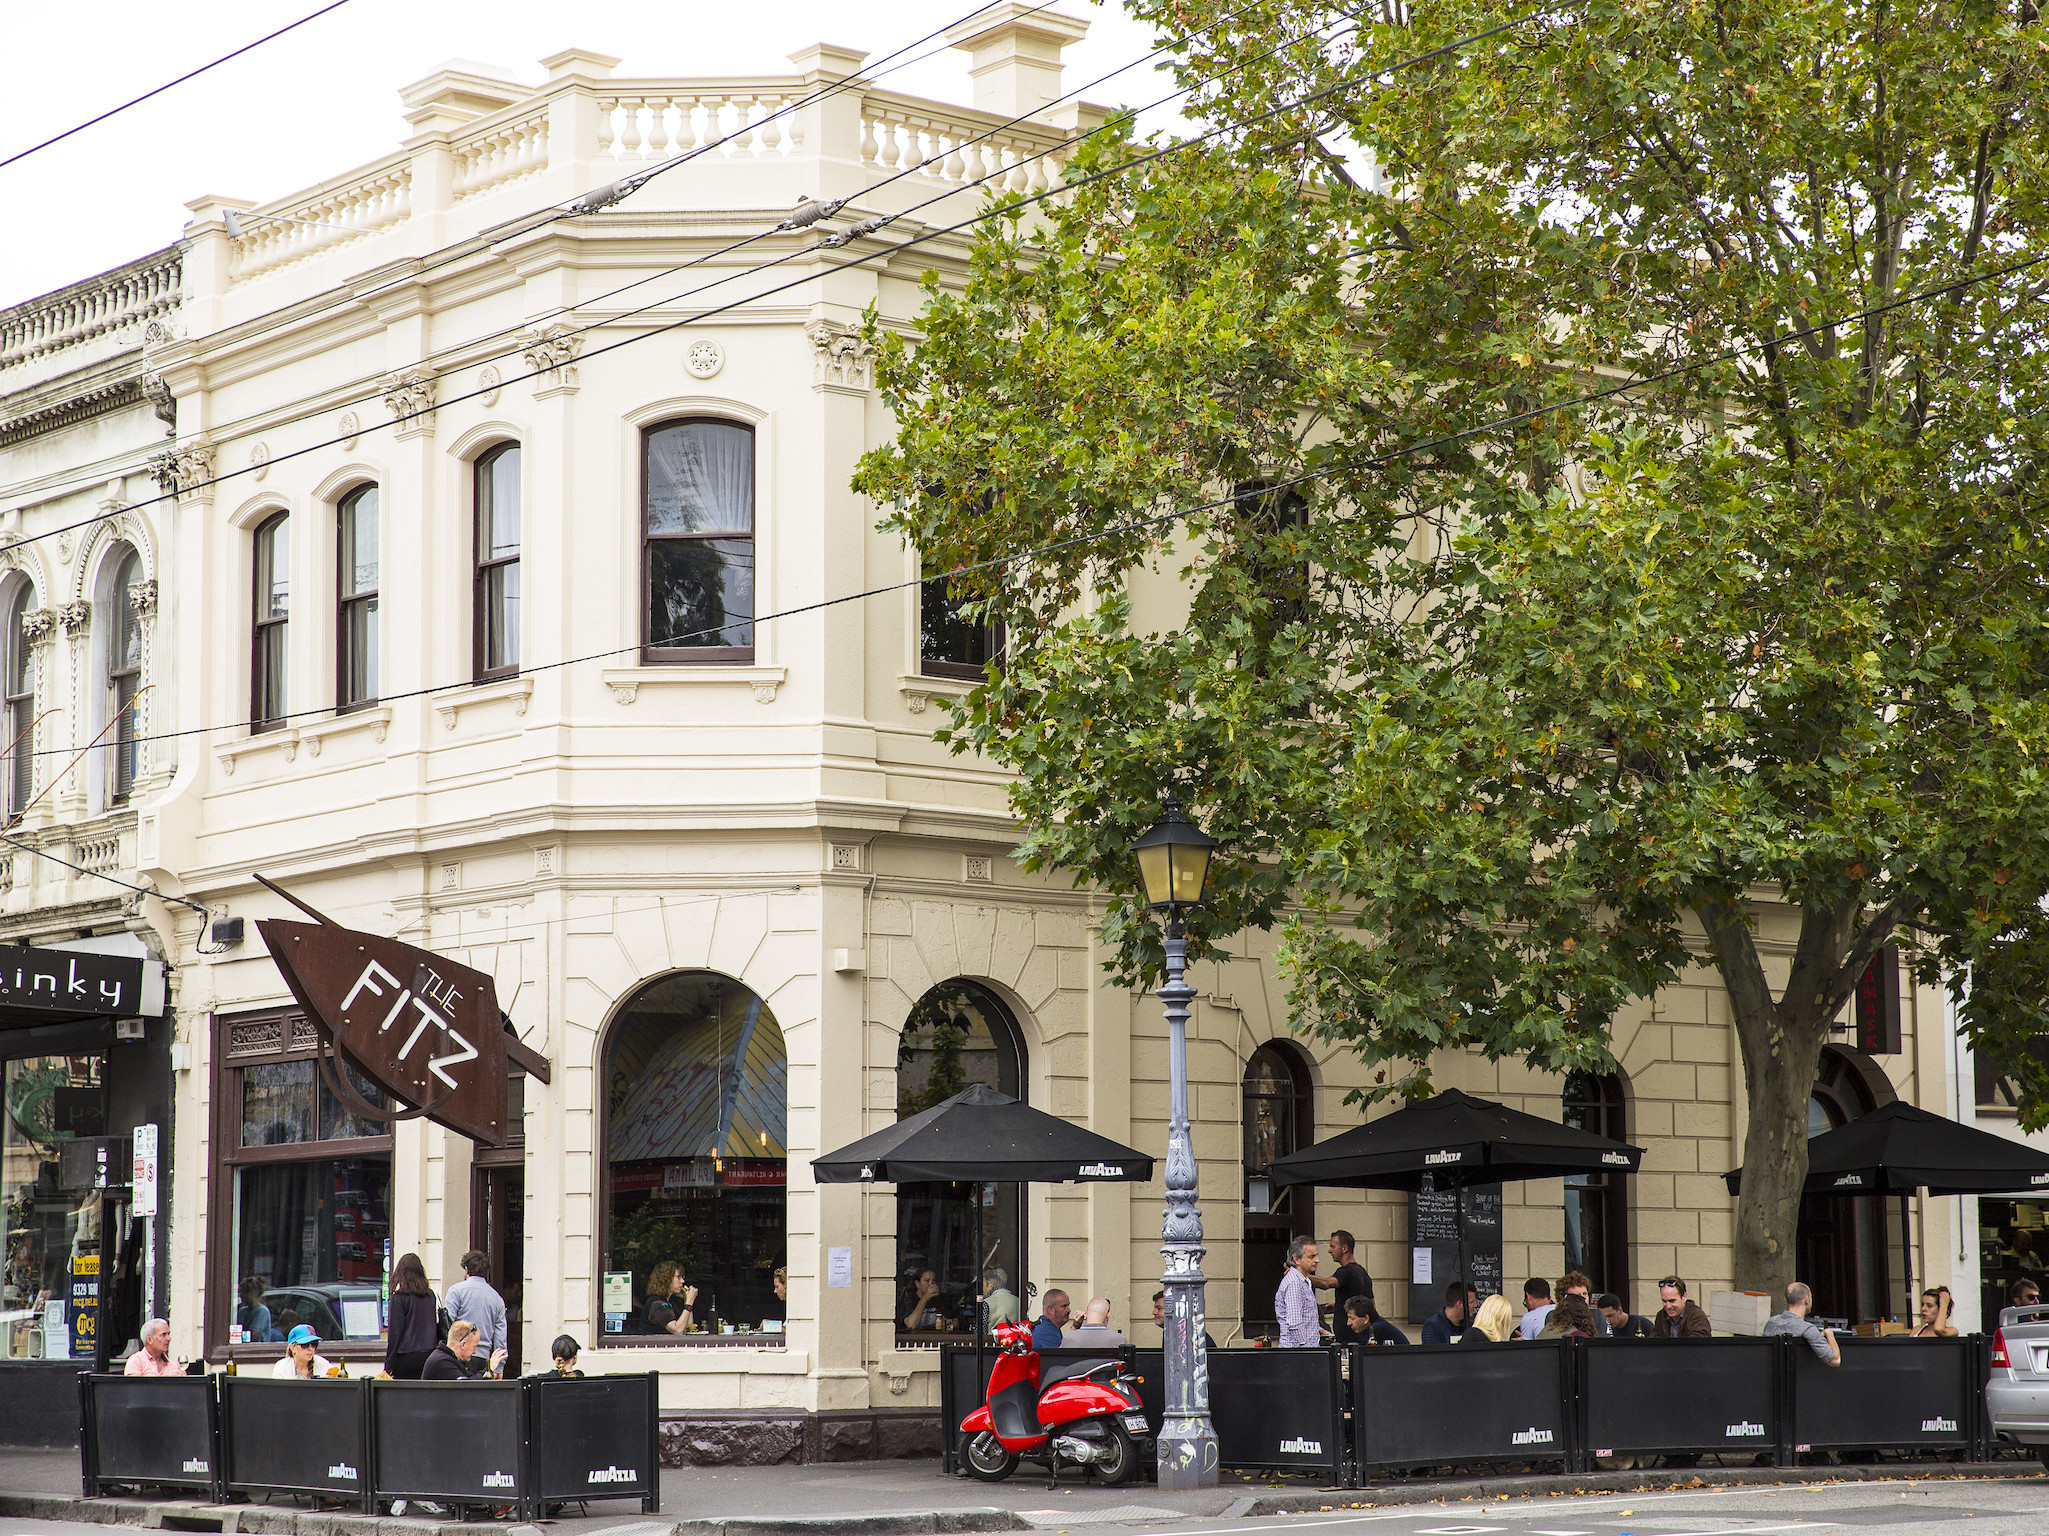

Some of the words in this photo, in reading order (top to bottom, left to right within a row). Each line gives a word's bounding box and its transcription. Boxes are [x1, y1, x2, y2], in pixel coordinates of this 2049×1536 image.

[0, 958, 122, 1007] inky
[340, 958, 479, 1091] FITZ
[137, 1129, 143, 1144] P
[1425, 1150, 1462, 1165] LAVAZZA
[1601, 1151, 1631, 1165] LAVAZZA
[1079, 1162, 1124, 1176] LAVAZZA
[74, 1260, 83, 1273] for
[85, 1259, 100, 1273] lease
[72, 1283, 87, 1296] 9329
[1725, 1420, 1766, 1437] LAVAZZA
[1921, 1415, 1958, 1432] LAVAZZA
[1511, 1426, 1554, 1445] LAVAZZA
[1279, 1436, 1322, 1455] LAVAZZA
[182, 1457, 209, 1473] LAVAZZA
[328, 1462, 358, 1480] LAVAZZA
[482, 1470, 515, 1488] LAVAZZA
[587, 1465, 638, 1484] LAVAZZA
